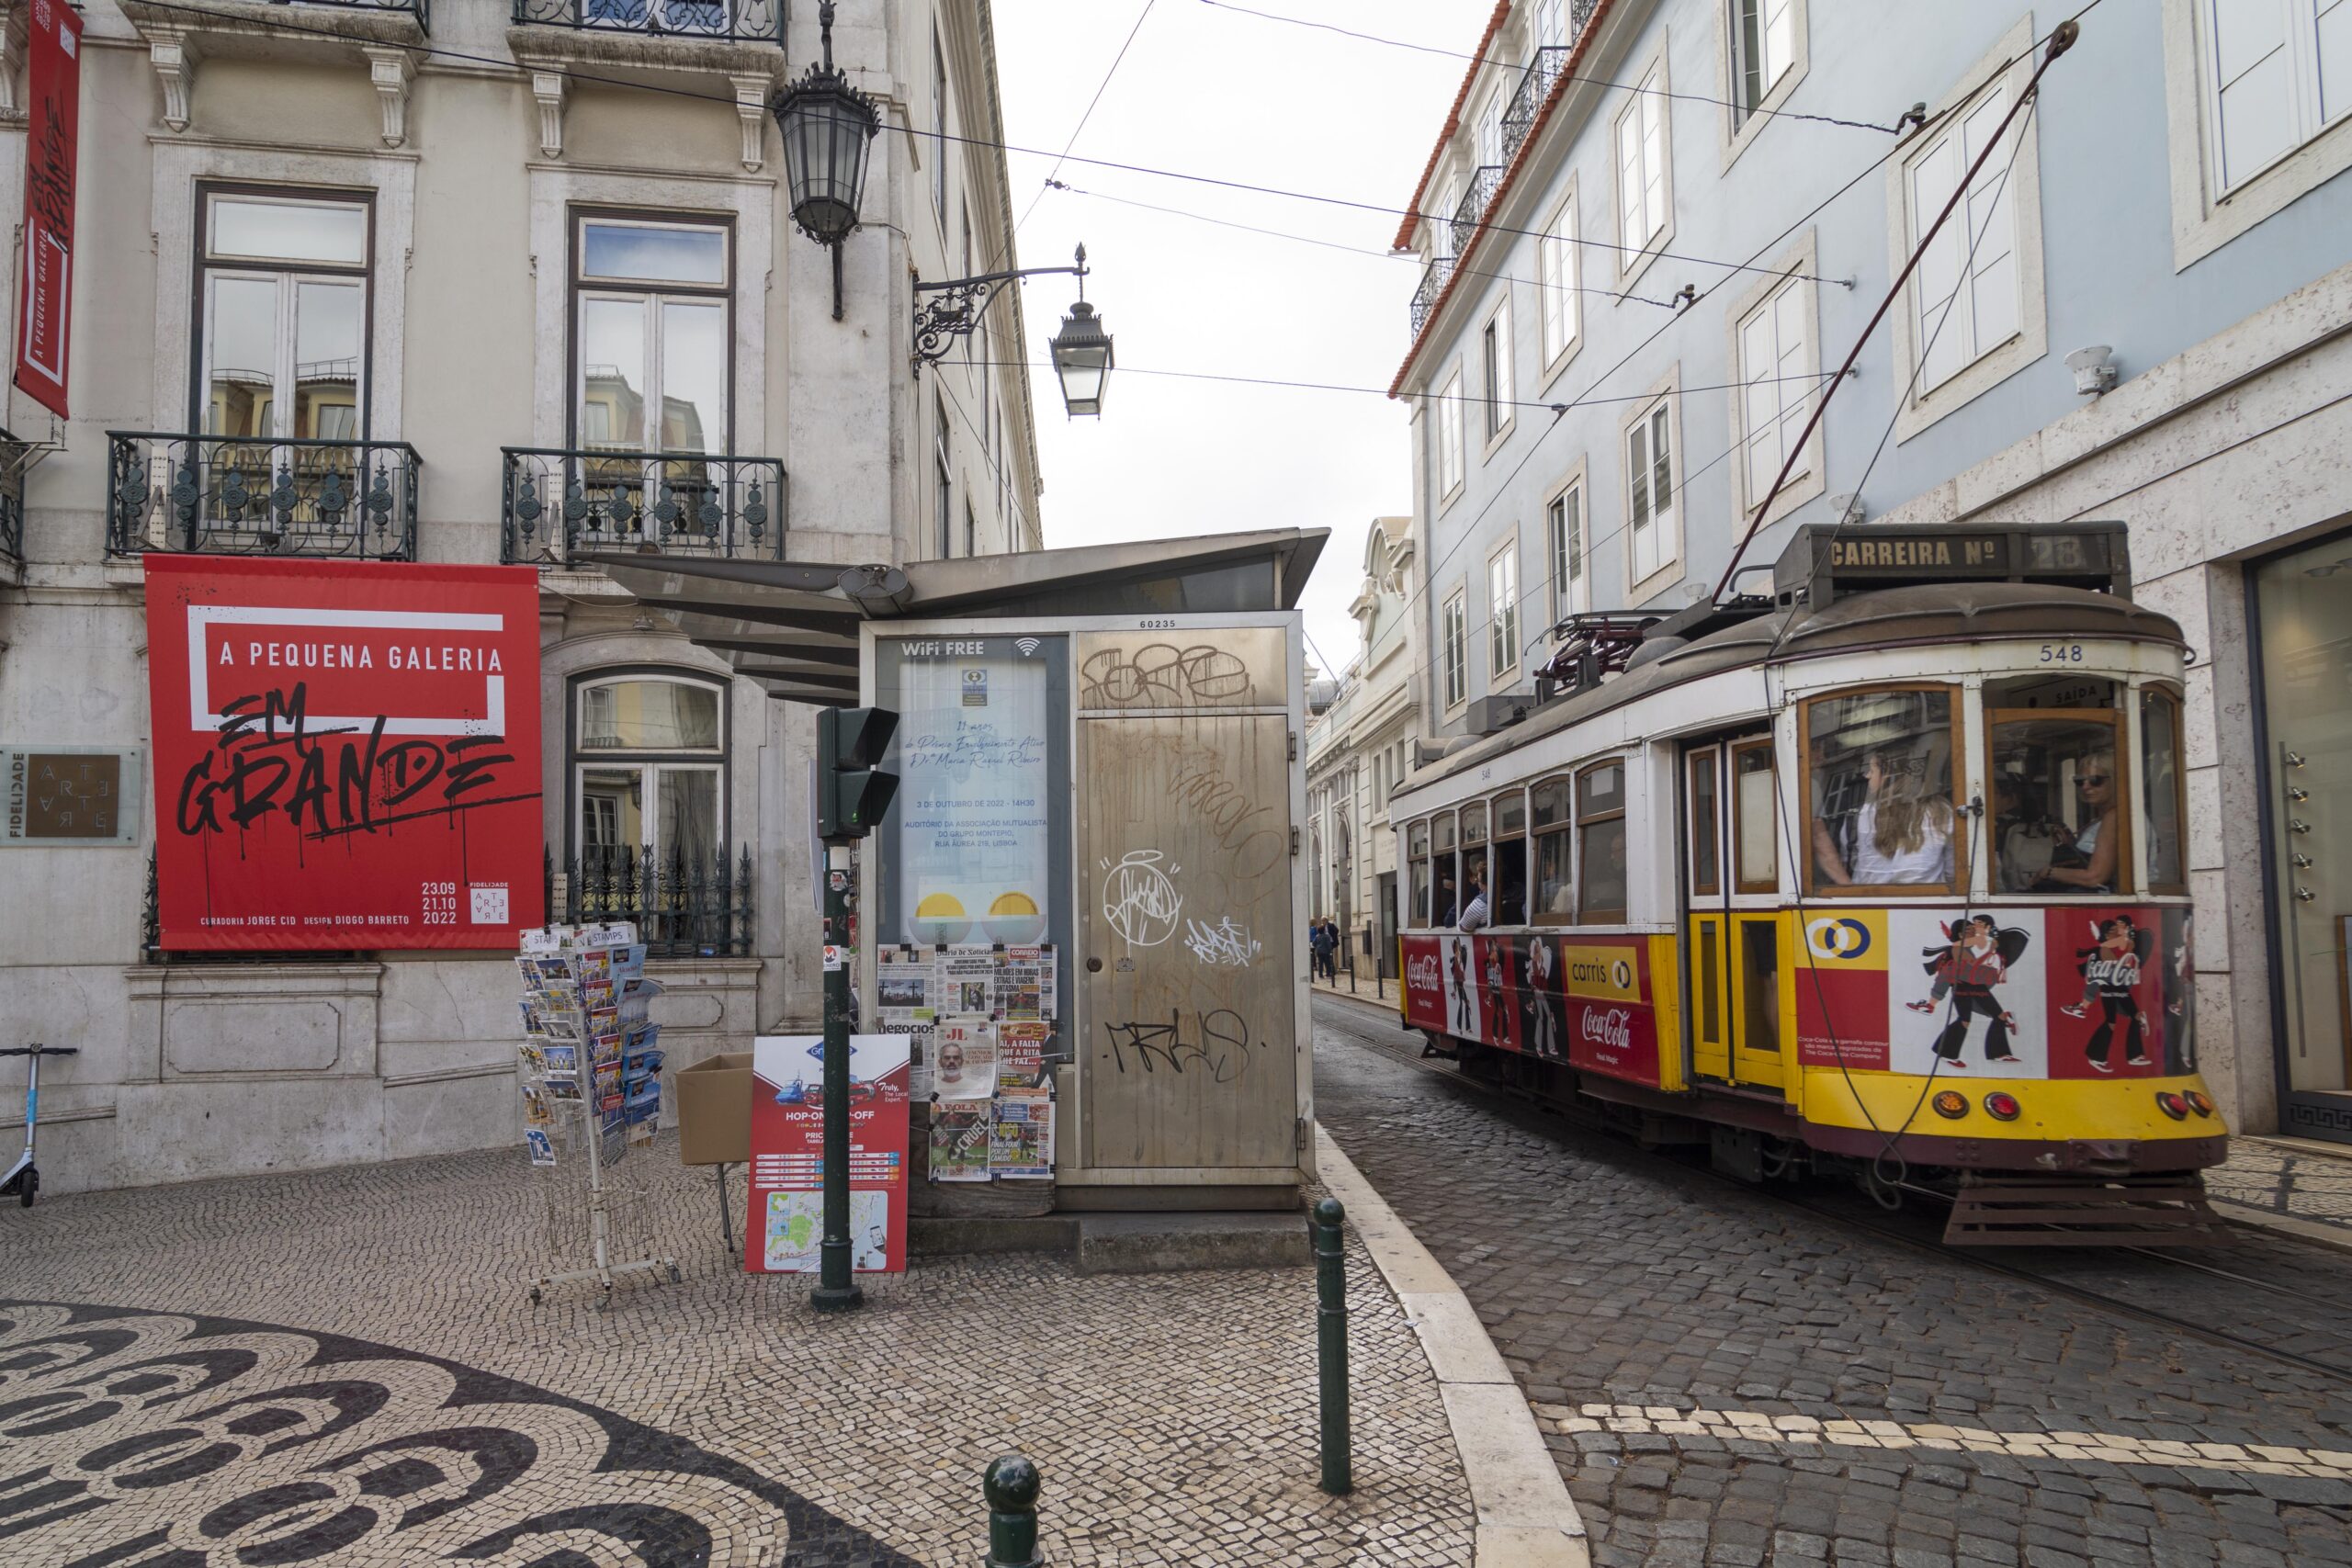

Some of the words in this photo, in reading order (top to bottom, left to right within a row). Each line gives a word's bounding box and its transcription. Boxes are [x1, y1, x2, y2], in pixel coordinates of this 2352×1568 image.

[39, 229, 48, 282] GALERIA
[35, 288, 46, 344] PEQUENA
[35, 349, 43, 358] A
[1830, 541, 1951, 566] CARREIRA
[1965, 541, 1994, 565] Nº
[1140, 620, 1175, 628] 60235
[901, 641, 939, 656] WiFi
[945, 641, 984, 655] FREE
[2040, 645, 2083, 662] 548
[220, 641, 233, 665] A
[250, 642, 373, 669] PEQUENA
[389, 646, 503, 672] GALERIA
[218, 681, 309, 755] EM
[935, 752, 966, 770] Maria
[970, 751, 1003, 769] Raquel
[1008, 750, 1041, 767] Ribeiro
[177, 715, 514, 836] GRANDE
[935, 800, 973, 808] OUTUBRO
[987, 799, 1004, 807] 2022
[905, 819, 943, 829] AUDITÓRIO
[956, 818, 1001, 829] ASSOCIAÇÃO
[1002, 818, 1046, 827] MUTUALISTA
[934, 840, 949, 848] RUA
[992, 839, 1018, 847] LISBOA
[422, 882, 456, 895] 23.09
[423, 897, 457, 910] 21.10
[200, 917, 244, 926] CURADORIA
[247, 916, 276, 925] JORGE
[280, 916, 296, 925] CID
[304, 917, 332, 925] DESIGN
[335, 915, 364, 924] DIOGO
[368, 915, 409, 925] BARRETO
[423, 911, 457, 924] 2022
[594, 931, 623, 942] STAMPS
[1408, 954, 1439, 992] Coca-Cola
[1572, 956, 1607, 983] carris
[993, 976, 1012, 985] EXTRAS
[993, 984, 1020, 993] FANTASMA
[1582, 1005, 1631, 1049] Coca-Cola
[999, 1040, 1010, 1048] AI,
[999, 1048, 1013, 1056] QUE
[1023, 1048, 1041, 1056] RITA
[878, 1082, 899, 1092] Truly,
[956, 1120, 989, 1151] CRUEL
